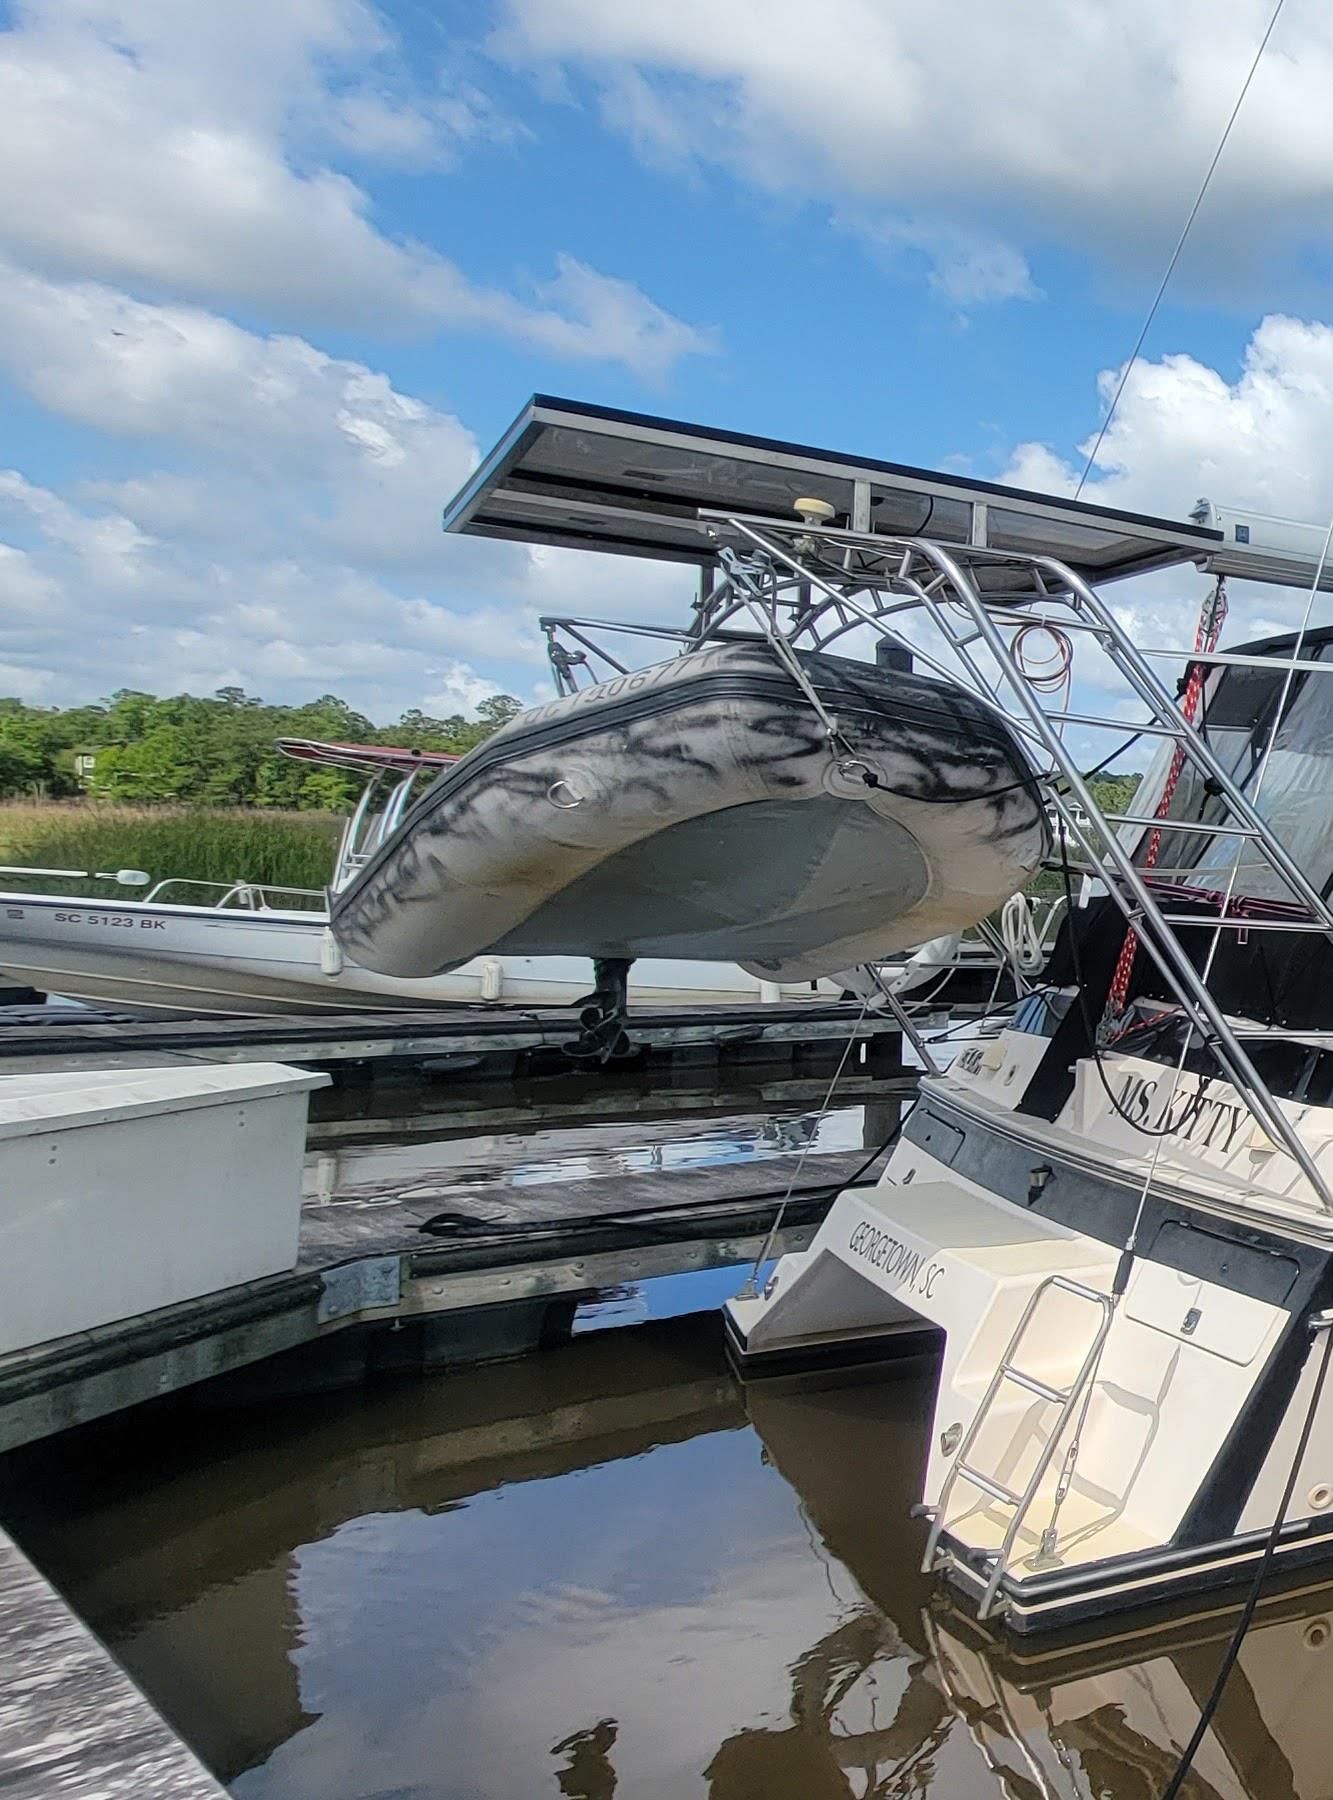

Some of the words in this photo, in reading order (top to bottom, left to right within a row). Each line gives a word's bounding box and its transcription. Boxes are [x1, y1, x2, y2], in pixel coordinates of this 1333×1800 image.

[54, 912, 82, 924] SC
[87, 915, 134, 928] 5123
[140, 919, 167, 930] BK
[1153, 1088, 1251, 1154] KITTY
[918, 1263, 946, 1299] SC
